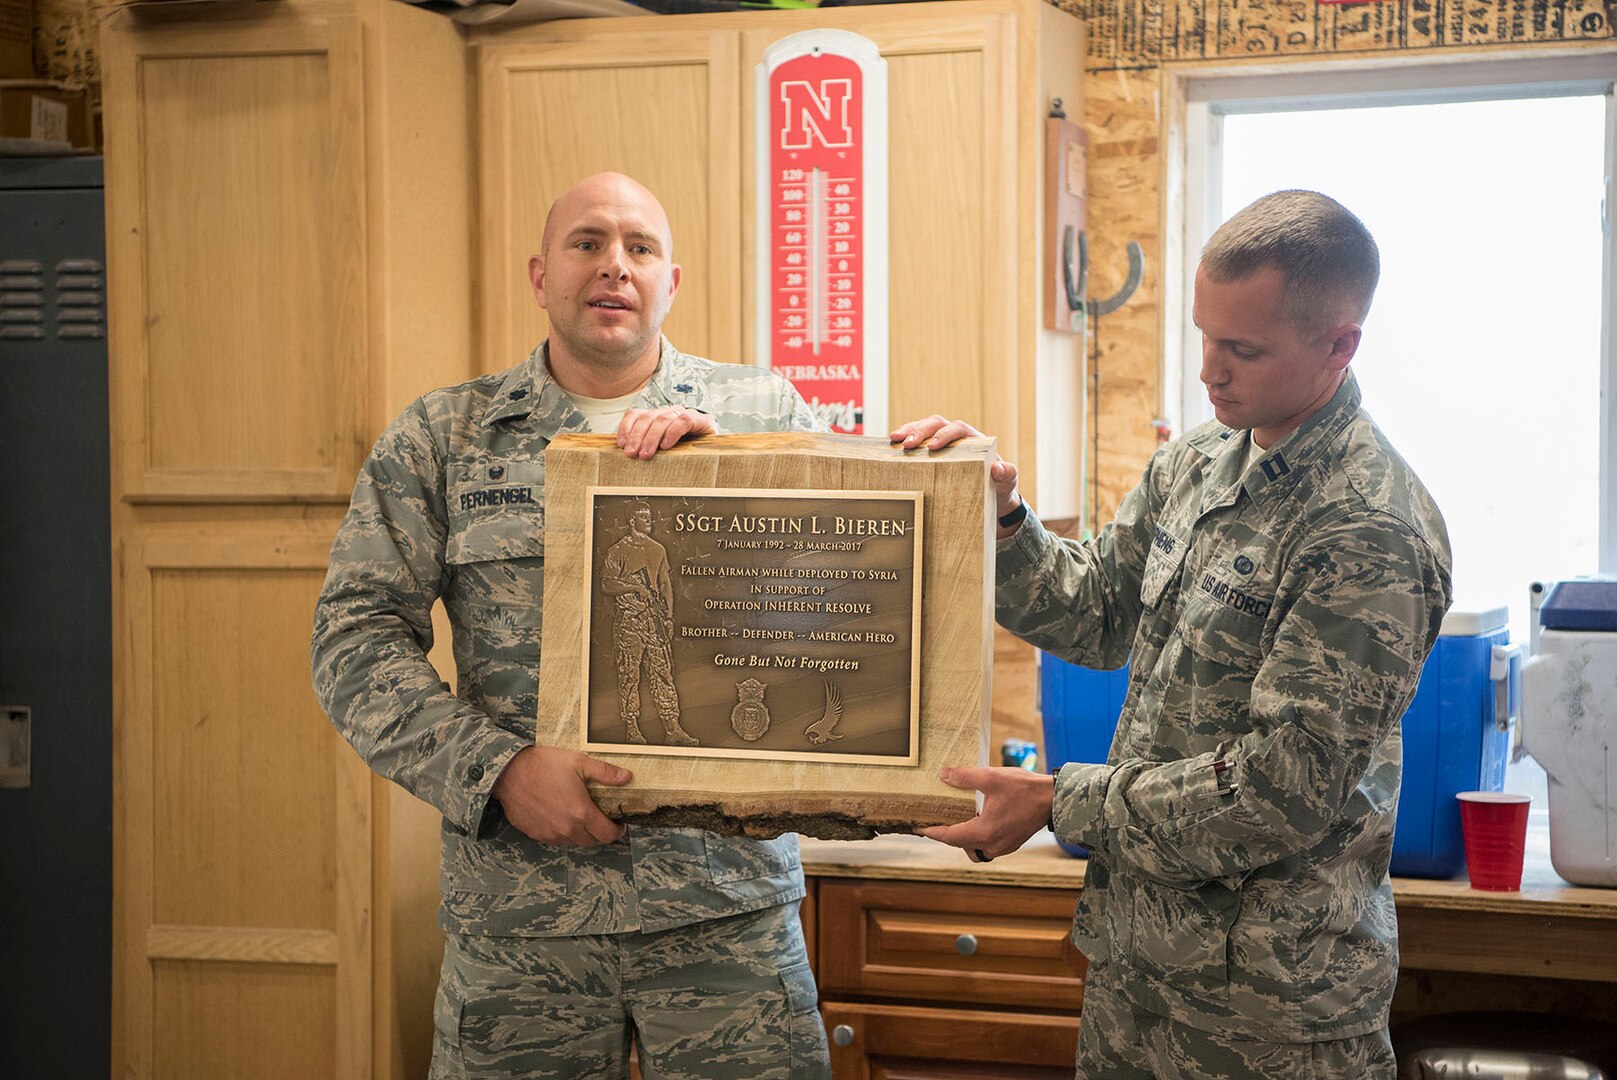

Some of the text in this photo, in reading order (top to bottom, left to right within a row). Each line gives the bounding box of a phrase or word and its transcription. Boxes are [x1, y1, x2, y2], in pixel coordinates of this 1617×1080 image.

[780, 77, 853, 150] N
[834, 184, 850, 195] 40
[834, 222, 850, 233] 20
[786, 232, 802, 244] 60
[786, 253, 802, 264] 40
[838, 260, 848, 272] 0
[787, 274, 802, 285] 20
[789, 295, 799, 306] 0
[832, 336, 852, 348] -40
[728, 514, 802, 534] AUSTIN
[810, 516, 826, 534] L.
[834, 516, 906, 536] BIEREN
[716, 539, 723, 549] 7
[724, 539, 762, 550] JANUARY
[764, 540, 785, 550] 1992
[793, 541, 804, 550] 28
[681, 565, 898, 581] FALLEN AIRMAN WHILE DEPLOYED TO SYRIA
[750, 585, 826, 596] IN SUPPORT OF
[1201, 573, 1216, 593] US
[1211, 582, 1229, 603] AIR
[704, 599, 872, 614] OPERATION INHERENT RESOLVE
[681, 627, 728, 638] BROTHER
[743, 629, 794, 640] DEFENDER
[808, 631, 862, 642] AMERICAN
[865, 633, 895, 644] HERO
[714, 654, 859, 672] Gone But Not Forgotten
